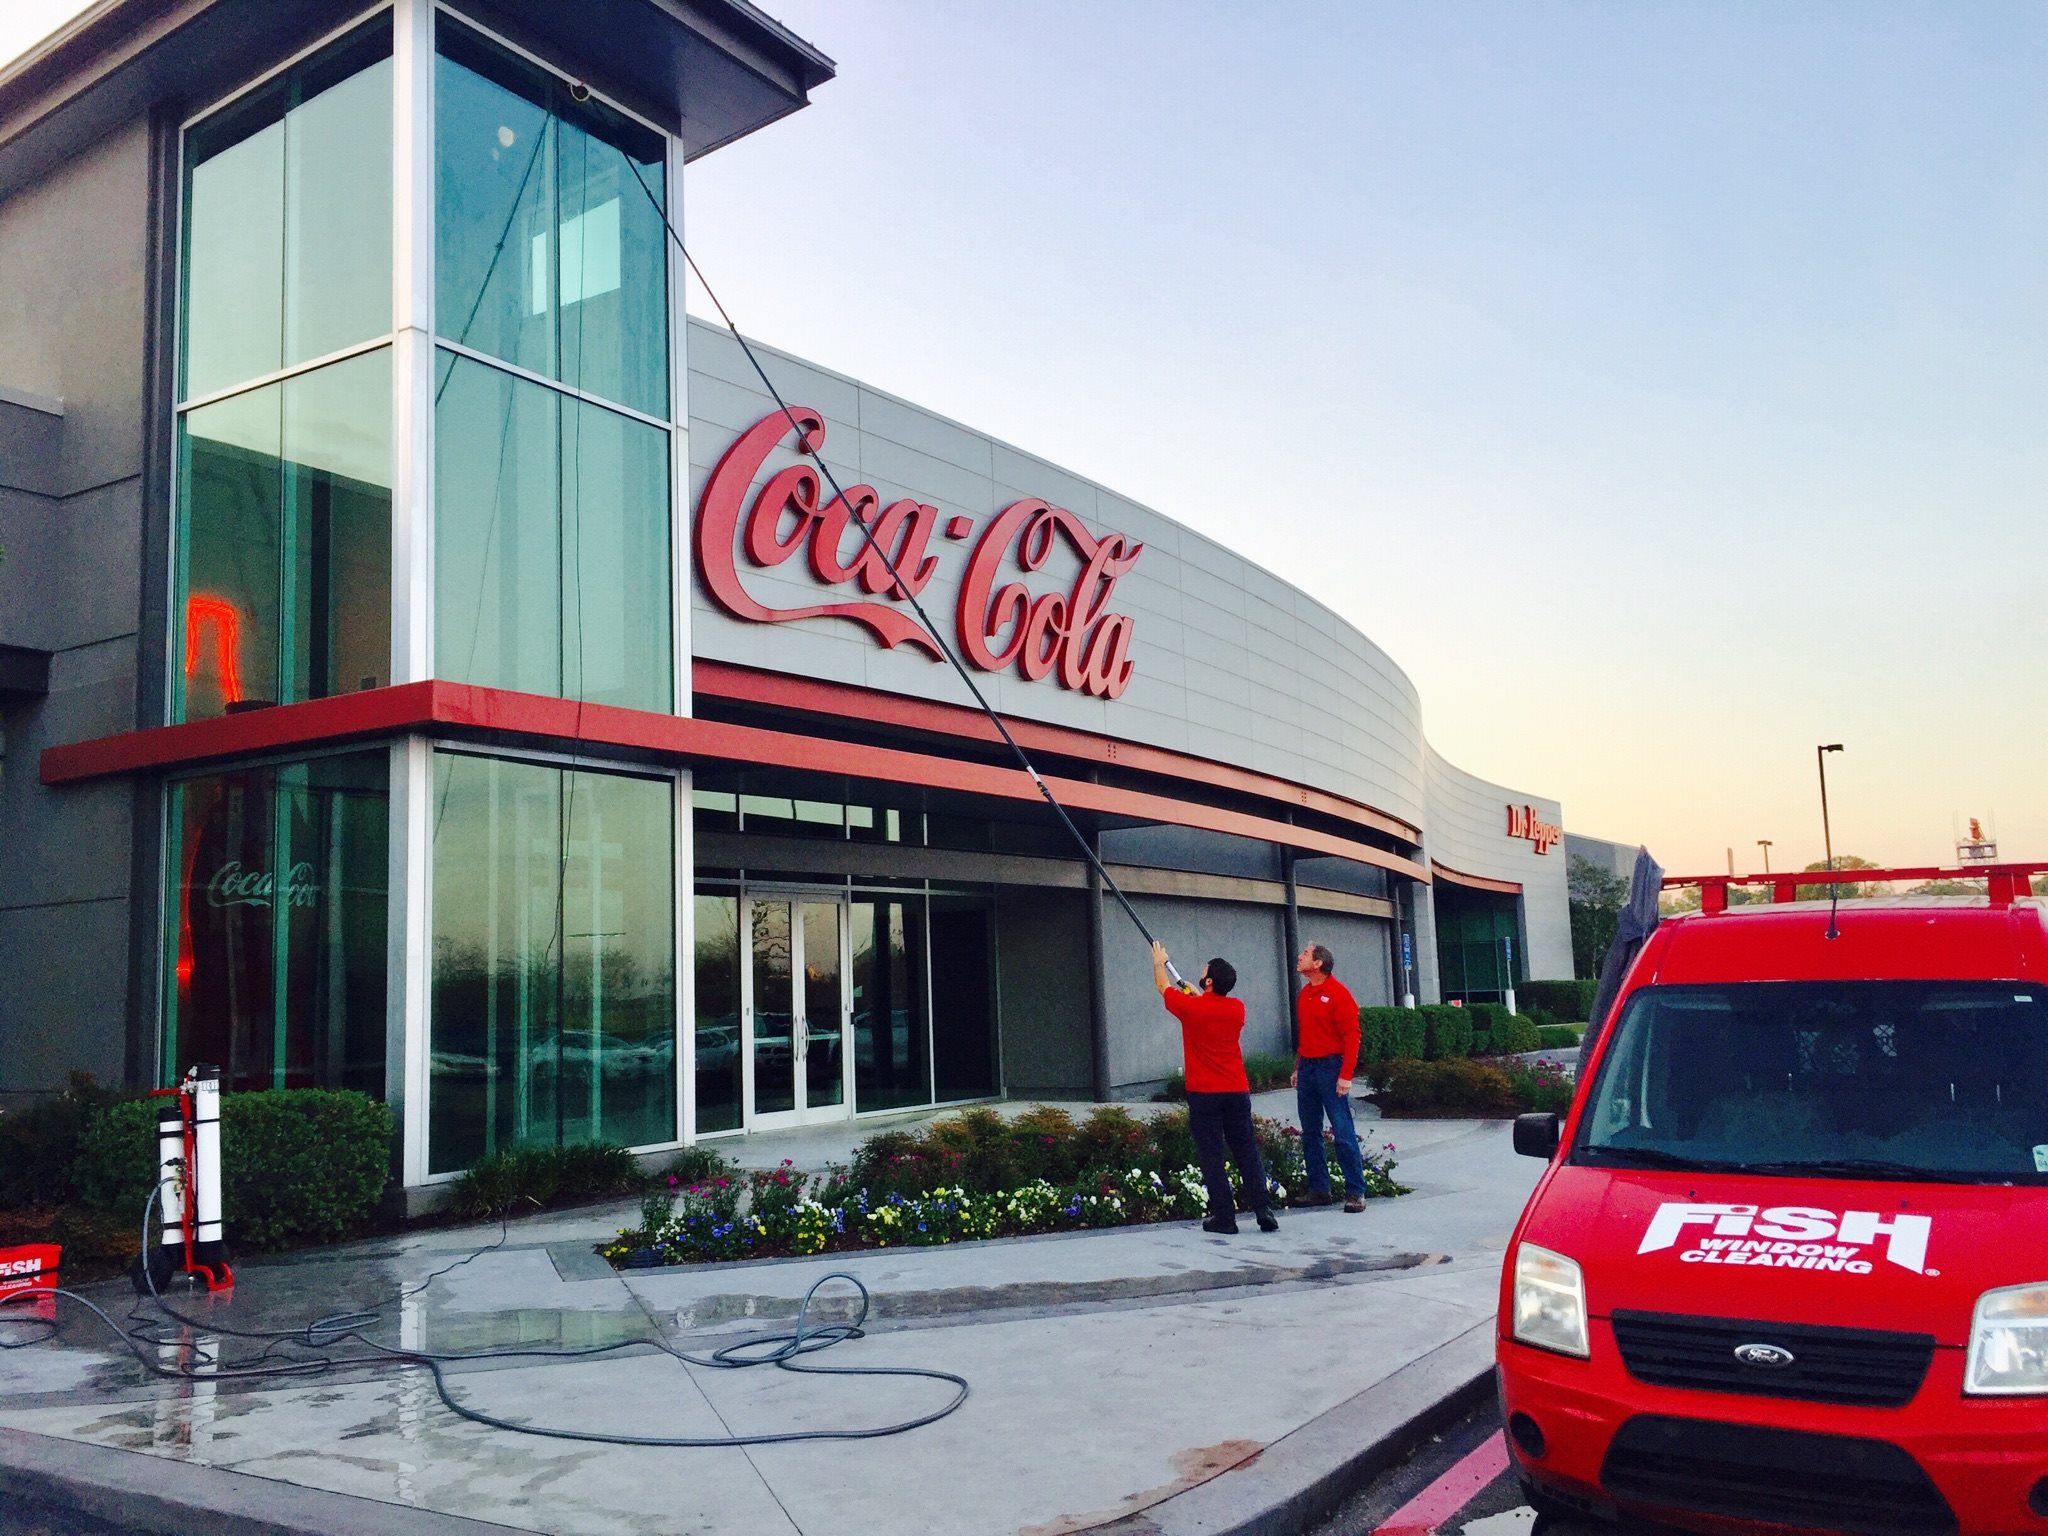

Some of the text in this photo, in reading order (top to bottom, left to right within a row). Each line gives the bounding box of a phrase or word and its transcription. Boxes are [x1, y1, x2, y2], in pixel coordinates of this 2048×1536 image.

[1506, 804, 1527, 838] Dr
[1700, 1237, 1860, 1260] WINDOW
[1679, 1250, 1873, 1275] CLEANING
